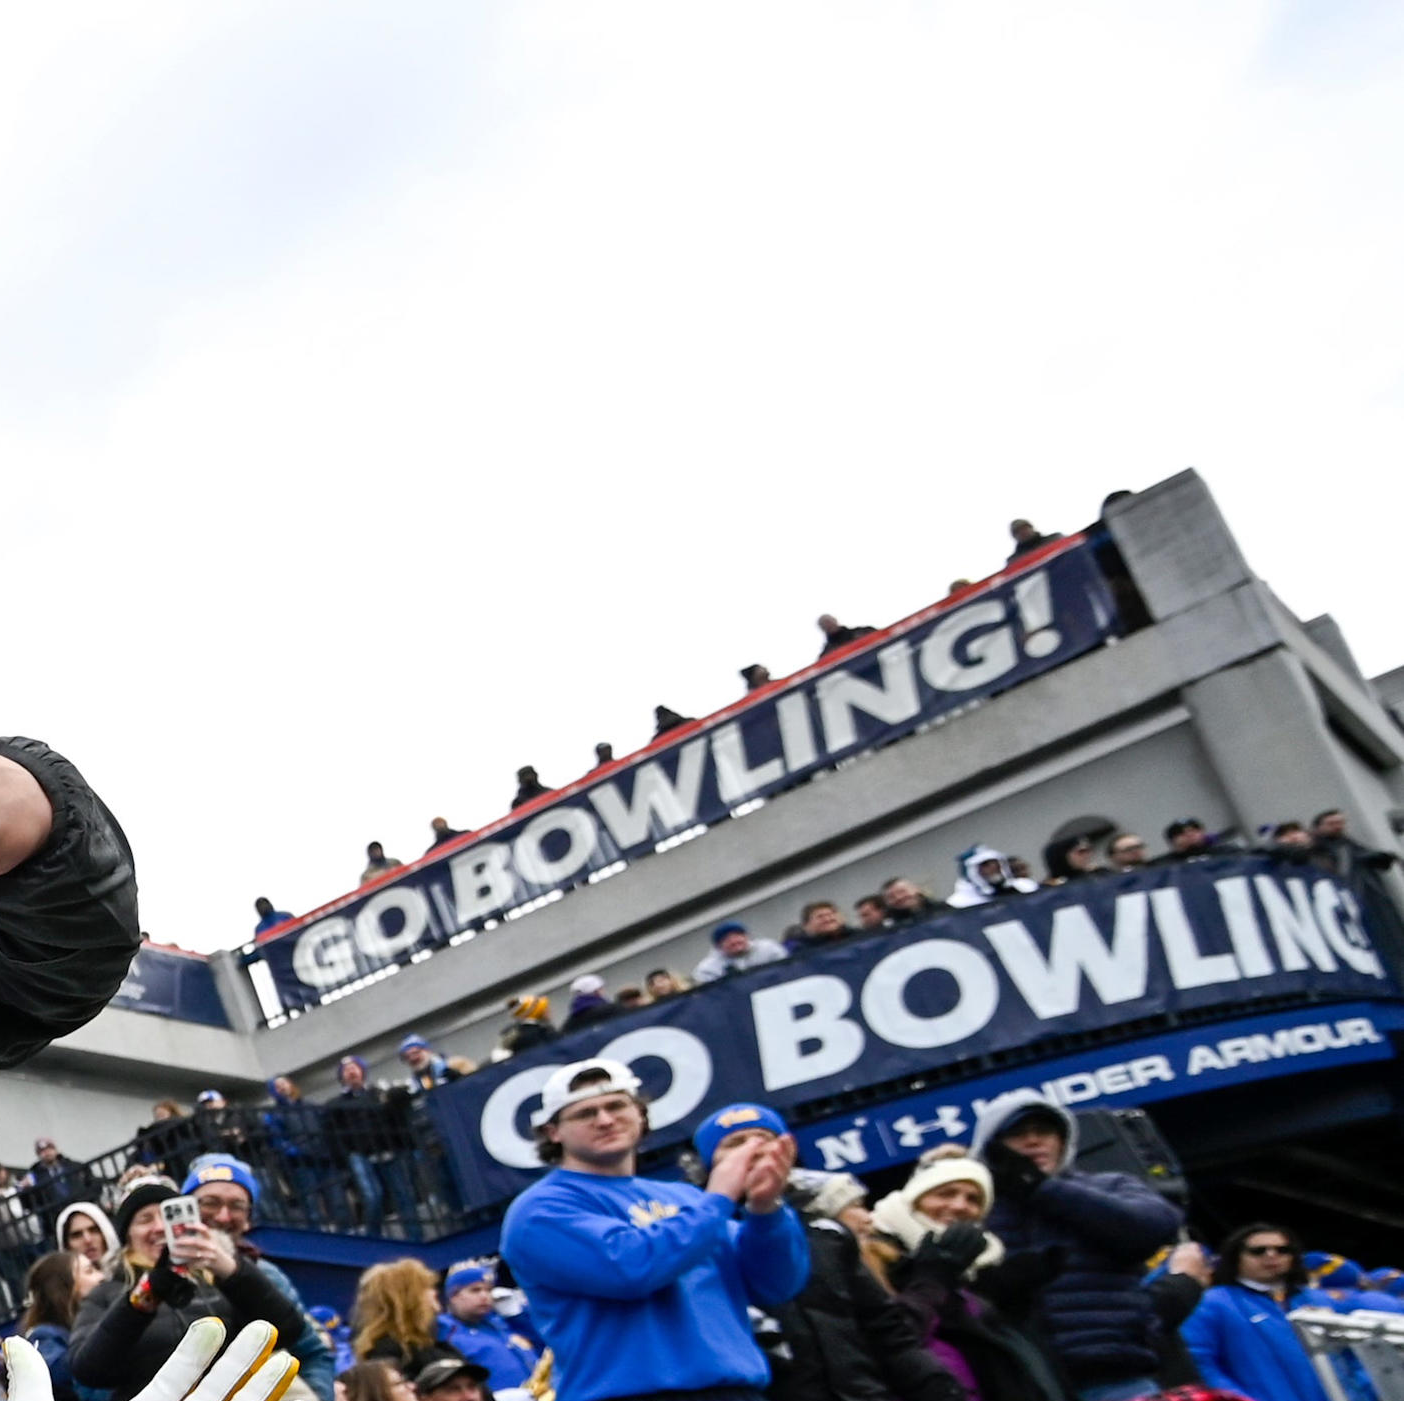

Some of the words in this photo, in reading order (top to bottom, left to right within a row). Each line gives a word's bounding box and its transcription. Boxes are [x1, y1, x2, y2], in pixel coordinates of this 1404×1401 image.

[292, 888, 430, 988] GO
[448, 568, 1062, 927] BOWLING!
[480, 1025, 713, 1169] GO
[1187, 1017, 1387, 1076] ARMOUR
